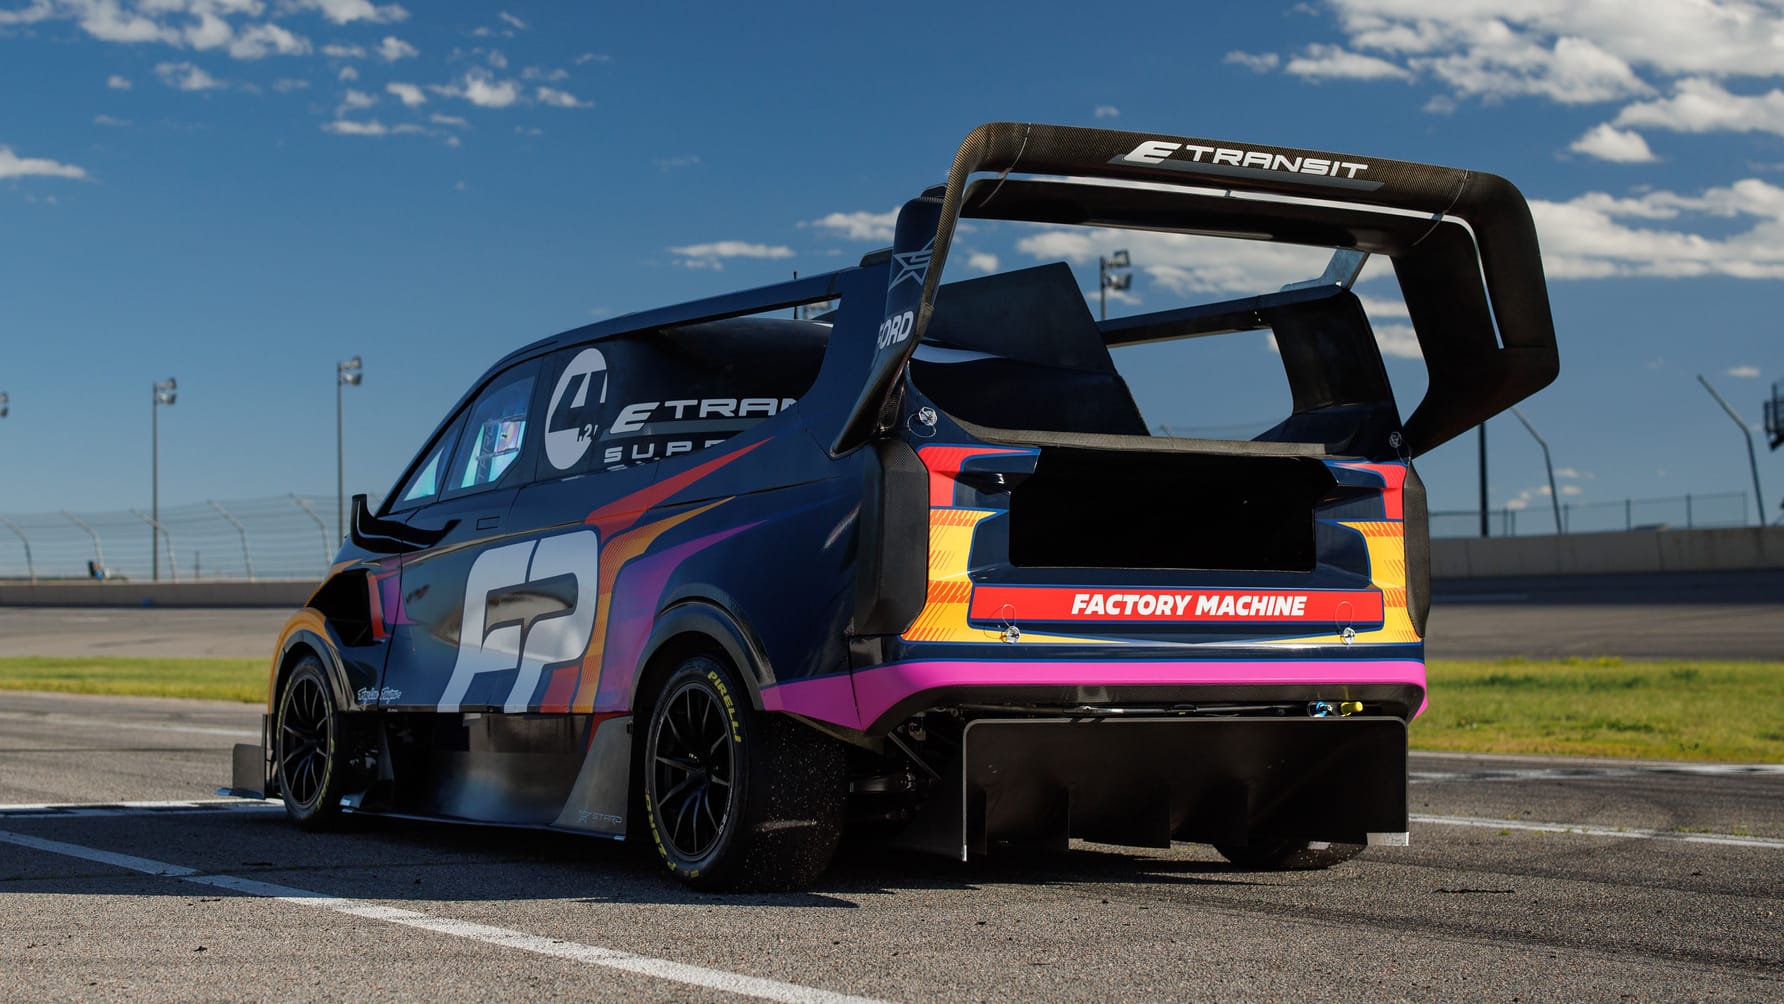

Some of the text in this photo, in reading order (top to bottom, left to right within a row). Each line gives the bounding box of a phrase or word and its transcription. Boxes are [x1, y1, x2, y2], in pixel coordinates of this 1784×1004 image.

[1071, 593, 1307, 617] FACTORY MACHINE
[706, 670, 742, 743] PIRELLI
